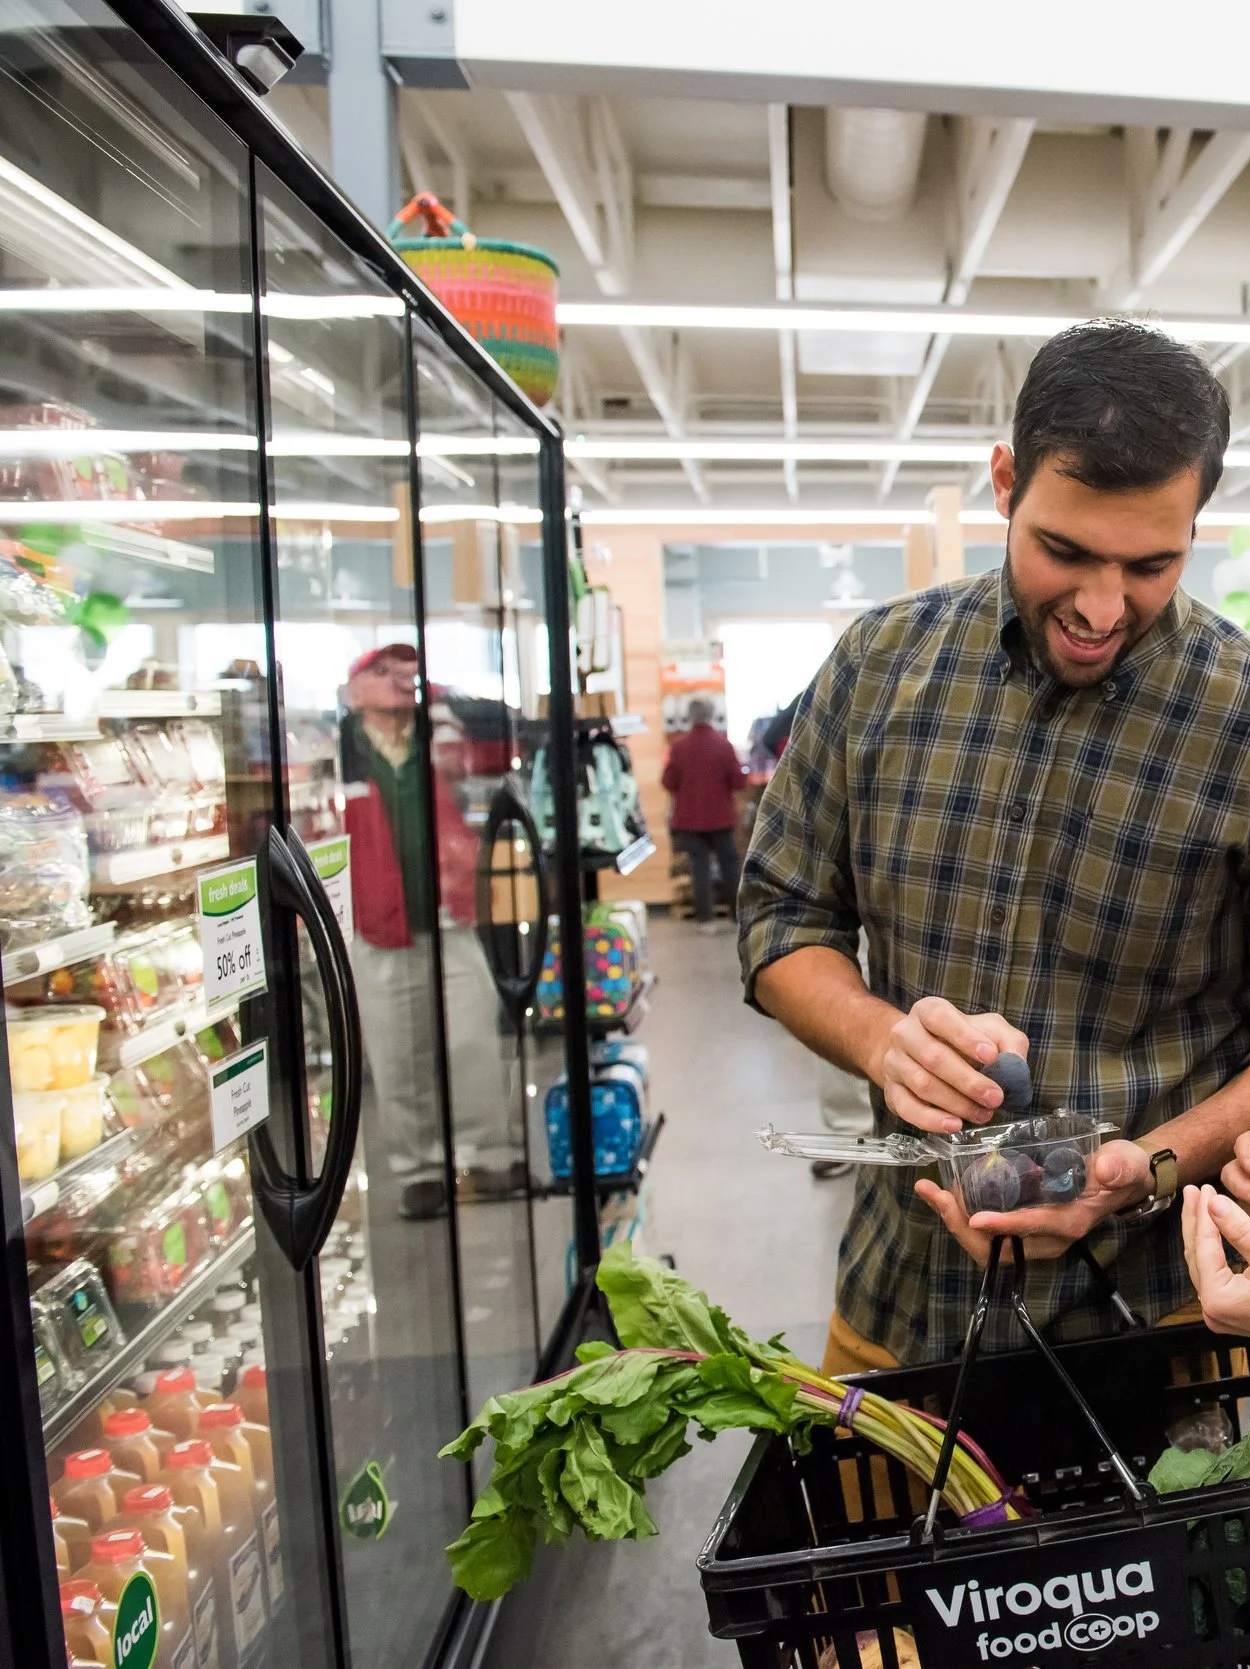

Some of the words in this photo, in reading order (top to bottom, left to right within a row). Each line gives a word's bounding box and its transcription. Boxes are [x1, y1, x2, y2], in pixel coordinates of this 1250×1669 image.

[209, 882, 229, 904] fresh
[229, 876, 248, 896] deals
[217, 950, 236, 980] 50%
[239, 944, 252, 970] off
[231, 1087, 242, 1101] Fresh
[243, 1081, 251, 1093] Cut
[925, 1560, 1155, 1628] Viroqua
[117, 1595, 154, 1666] local
[976, 1622, 1063, 1661] food
